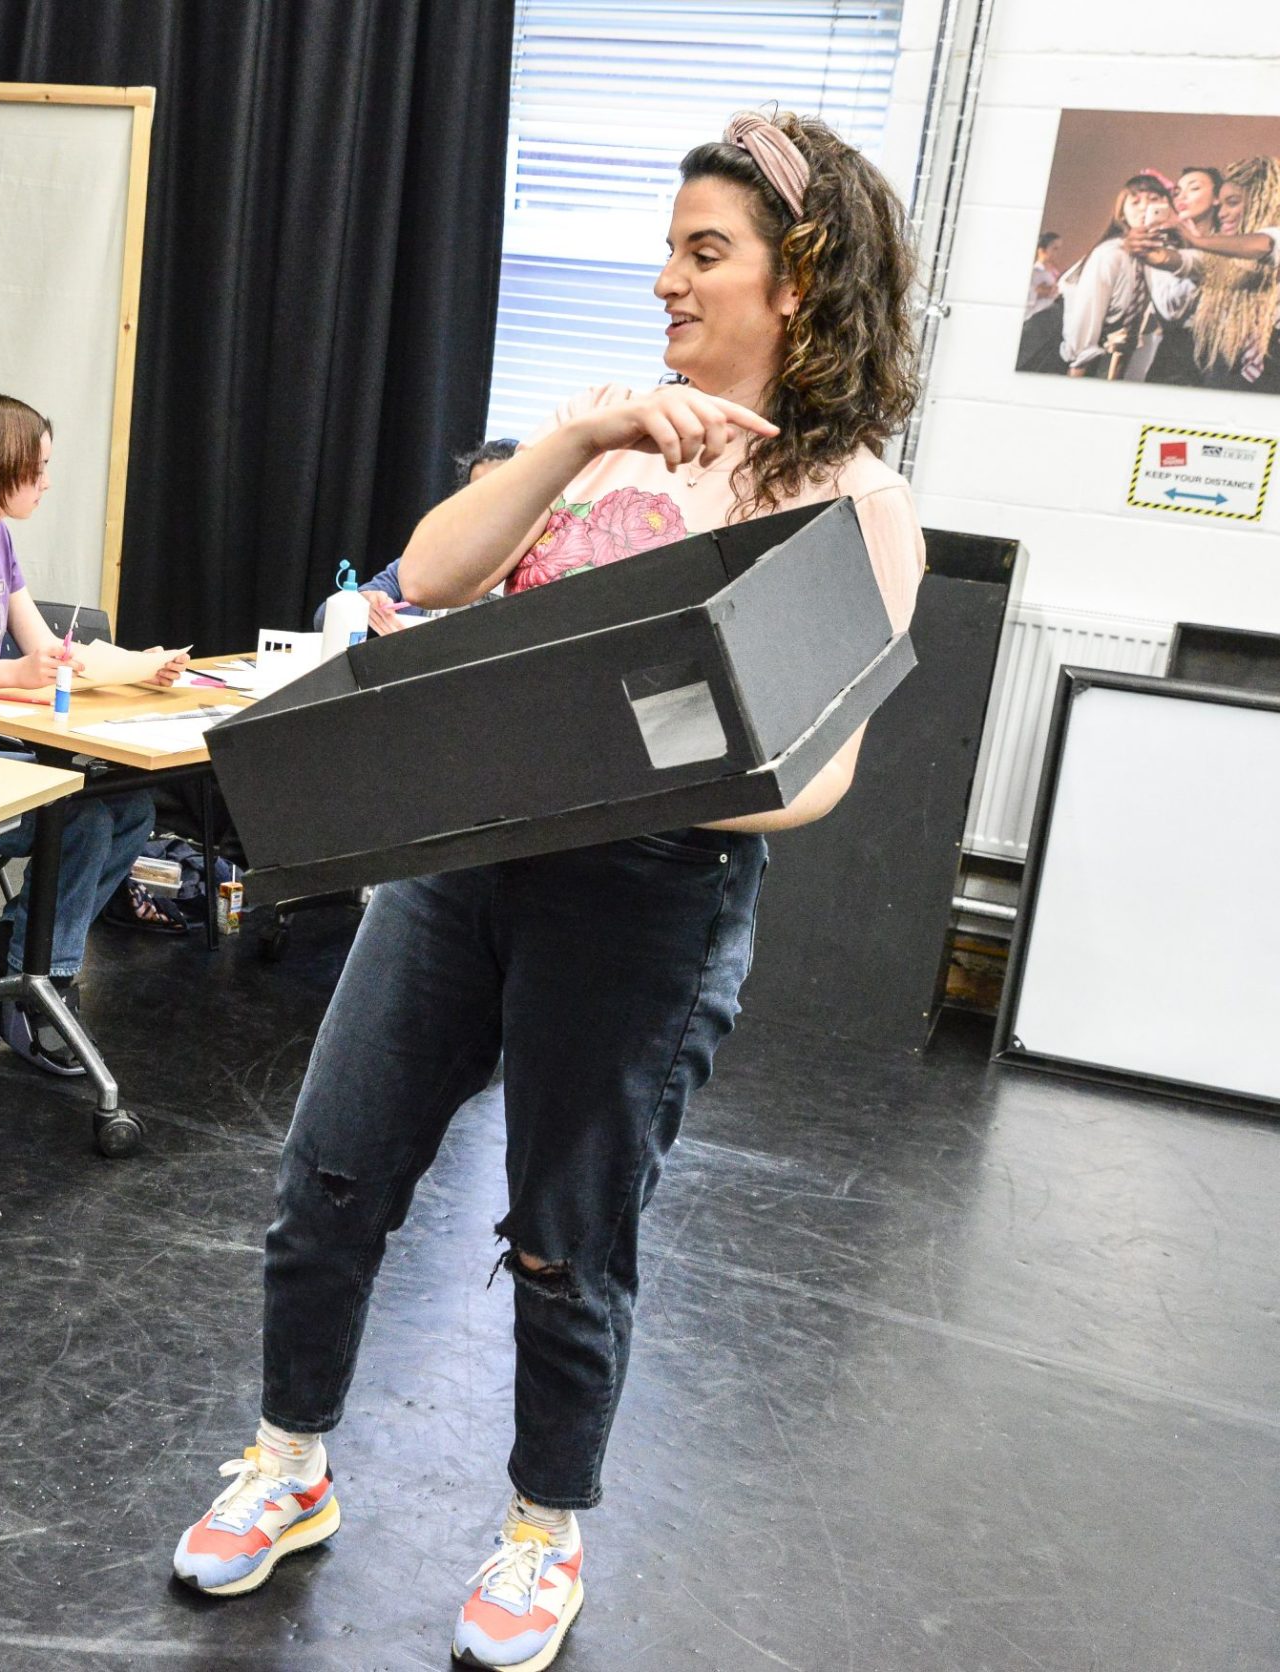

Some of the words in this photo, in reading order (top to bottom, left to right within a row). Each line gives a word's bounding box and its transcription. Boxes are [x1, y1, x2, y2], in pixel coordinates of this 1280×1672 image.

[1145, 470, 1172, 480] KEEP
[1175, 474, 1202, 484] YOUR
[1205, 477, 1256, 491] DISTANCE
